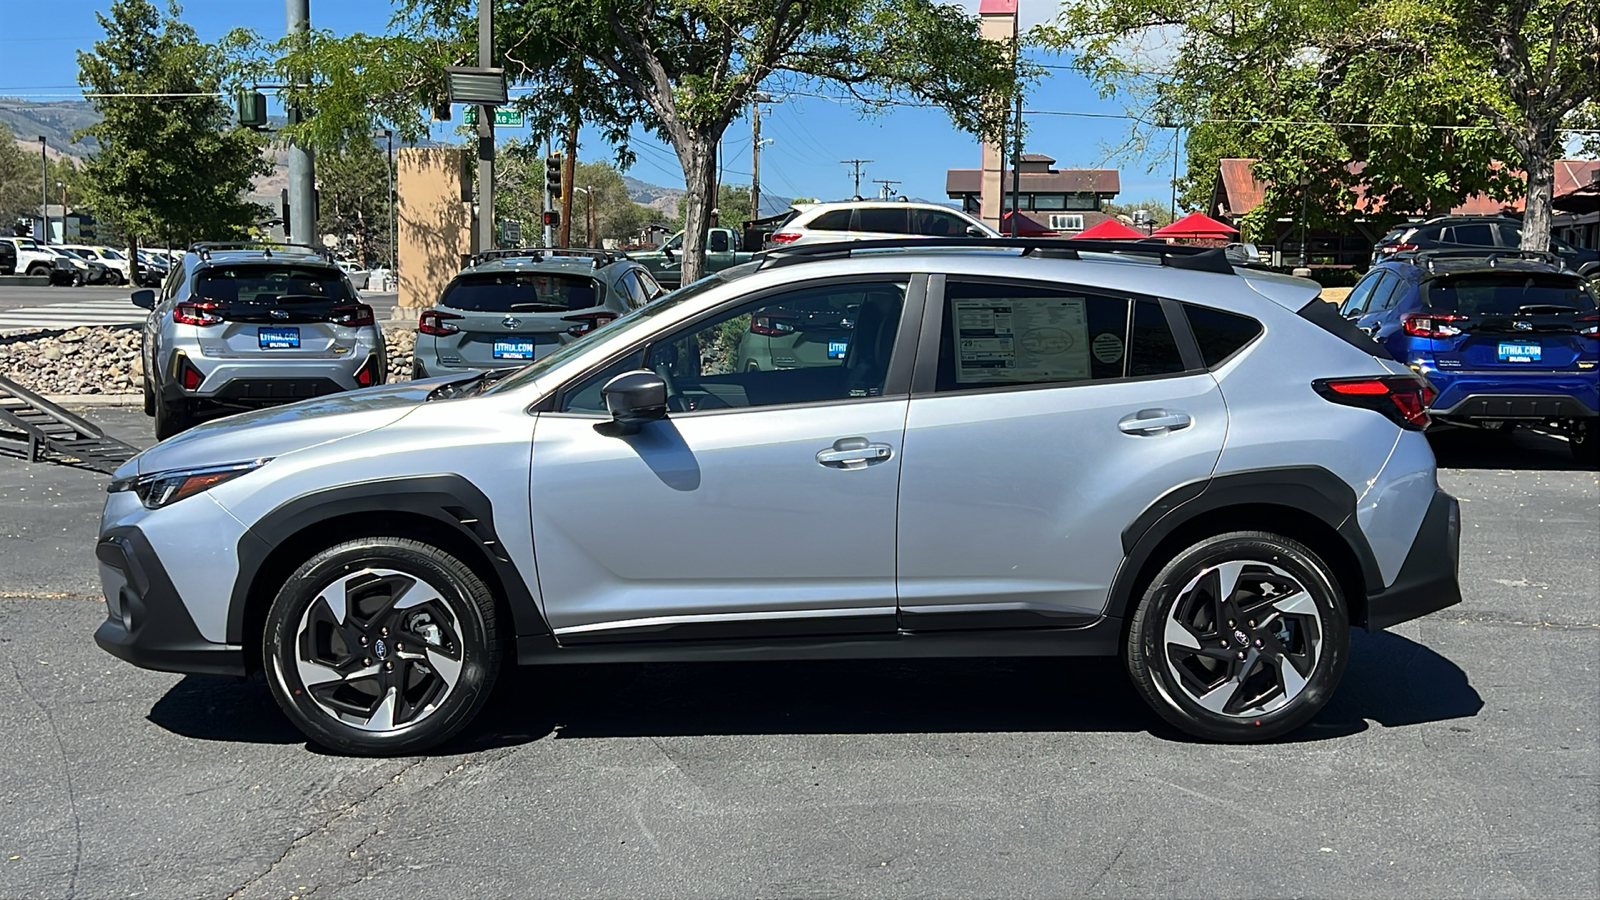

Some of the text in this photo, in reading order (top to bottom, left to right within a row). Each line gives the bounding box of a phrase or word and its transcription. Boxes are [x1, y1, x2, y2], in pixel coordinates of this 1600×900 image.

[260, 333, 299, 341] LITHIA.COM
[494, 343, 533, 352] LITHIA.COM
[829, 342, 848, 352] LITHI
[1499, 346, 1541, 355] LITHIA.COM
